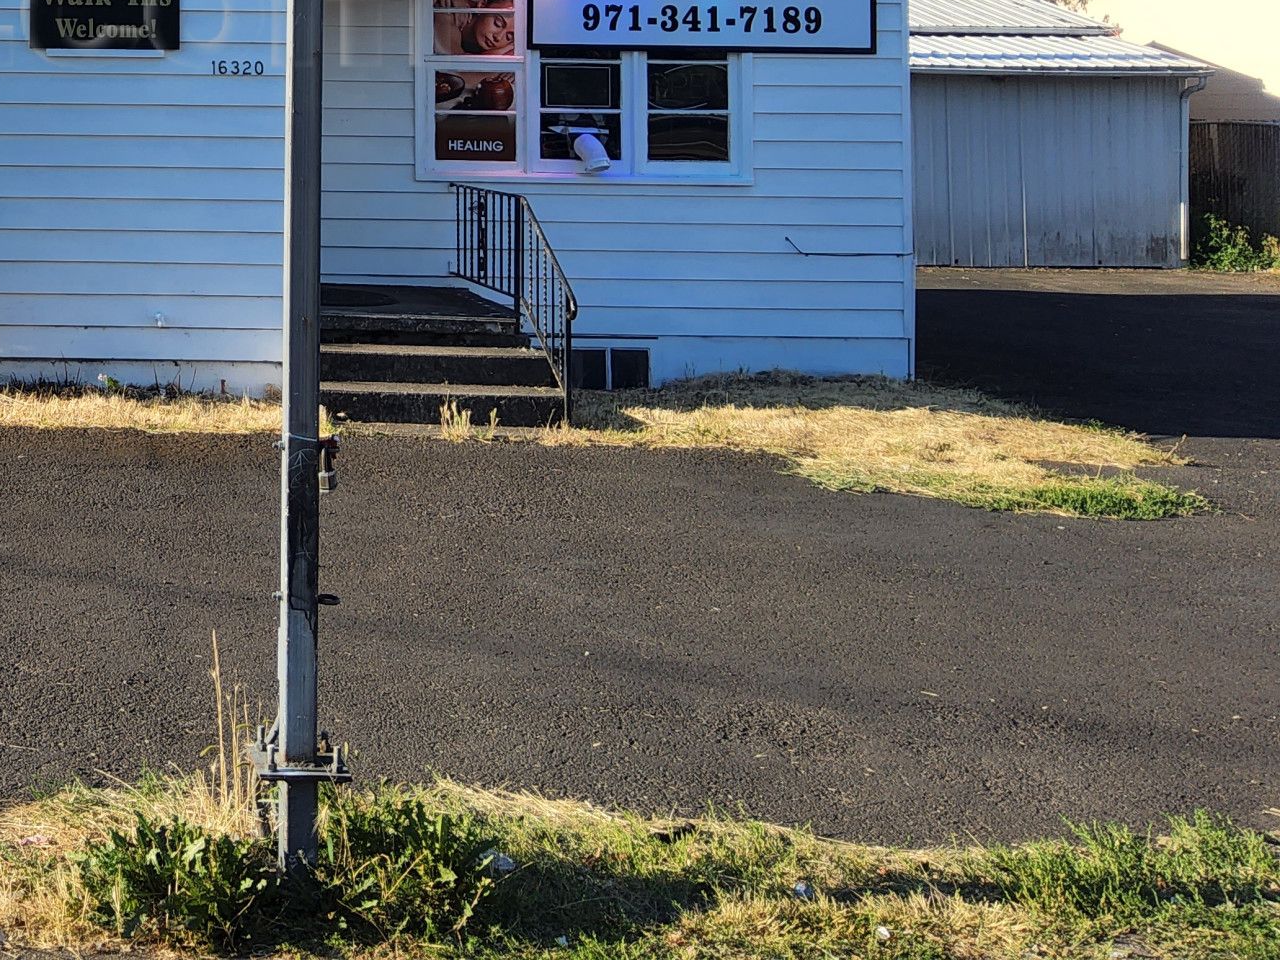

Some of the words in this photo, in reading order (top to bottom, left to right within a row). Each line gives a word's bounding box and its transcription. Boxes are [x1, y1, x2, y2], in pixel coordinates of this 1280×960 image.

[55, 17, 158, 39] Welcome!
[582, 4, 823, 34] 971-341-7189
[211, 60, 264, 76] 16320
[448, 139, 504, 152] HEALING
